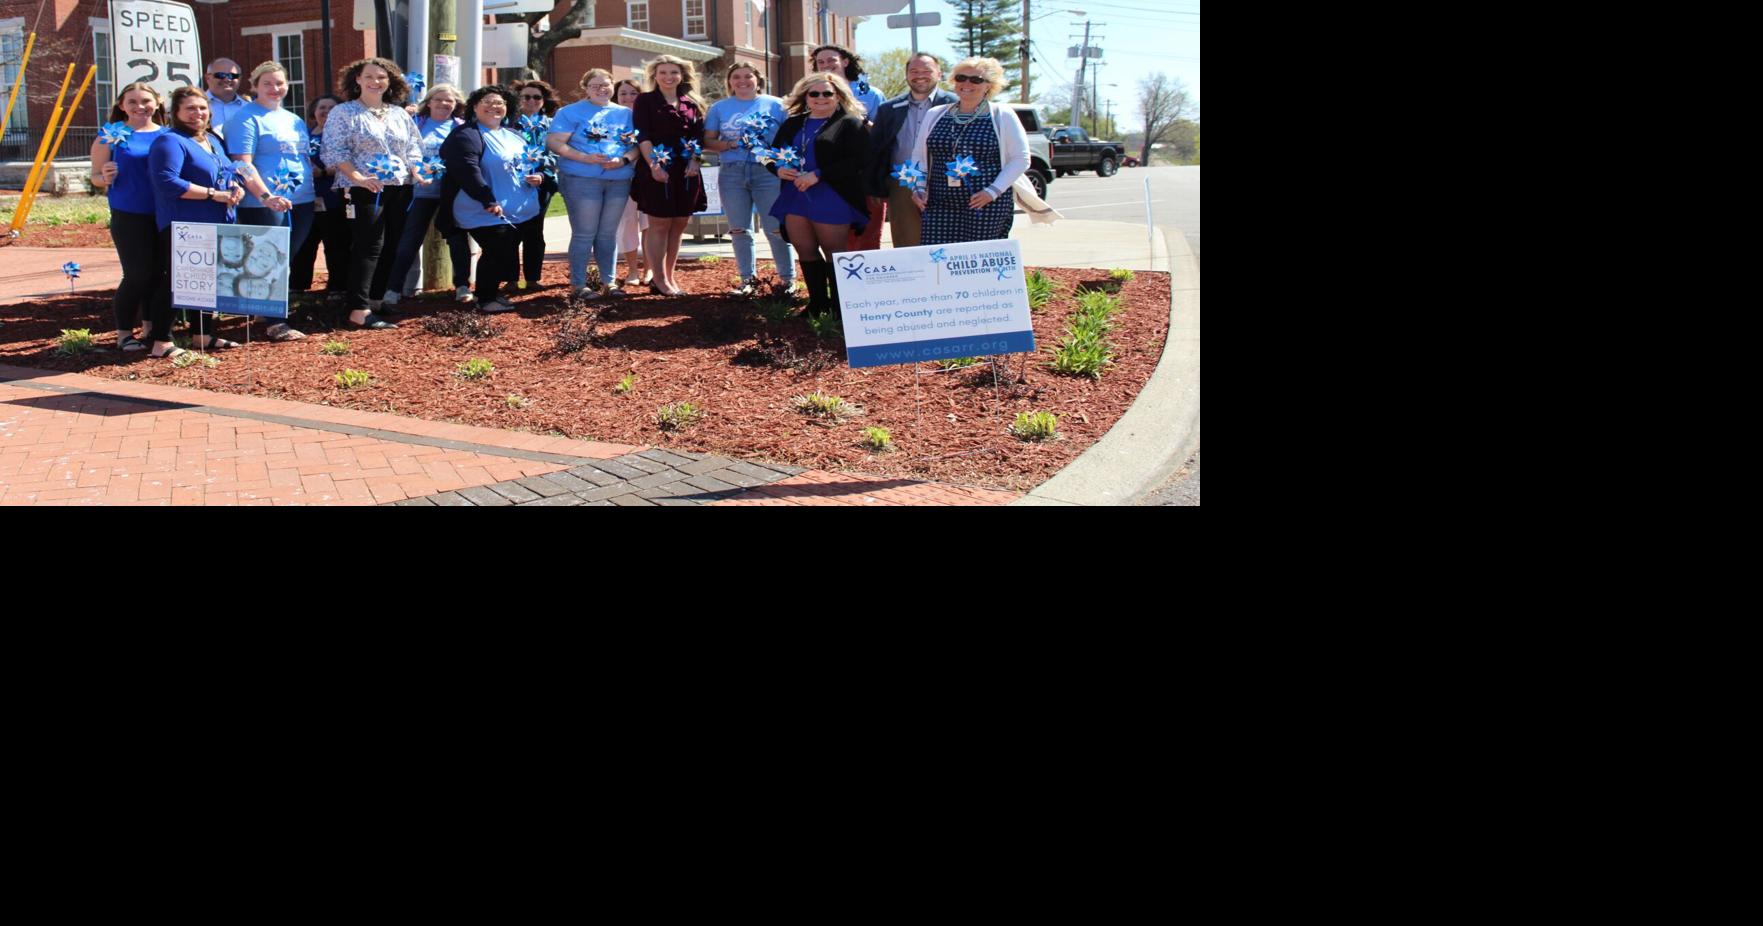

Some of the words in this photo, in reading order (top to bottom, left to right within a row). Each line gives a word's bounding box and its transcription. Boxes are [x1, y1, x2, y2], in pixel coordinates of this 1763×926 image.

[120, 9, 191, 33] SPEED
[130, 34, 185, 56] LIMIT
[126, 58, 193, 94] 25
[176, 250, 215, 266] YOU
[979, 250, 1013, 259] NATIONAL
[864, 265, 897, 274] CASA
[946, 260, 978, 271] CHILD
[981, 256, 1016, 268] ABUSE
[950, 267, 991, 276] PREVENTION
[176, 279, 214, 291] STORY
[845, 300, 871, 310] Each
[874, 299, 899, 309] year,
[902, 296, 928, 304] more
[930, 293, 953, 302] than
[955, 290, 969, 300] 70
[972, 286, 1012, 298] children
[1014, 287, 1024, 295] in
[860, 312, 892, 322] Henry
[894, 308, 933, 318] County
[936, 307, 953, 315] are
[955, 301, 999, 313] reported
[864, 325, 894, 335] being
[896, 320, 934, 332] abused
[936, 318, 956, 329] and
